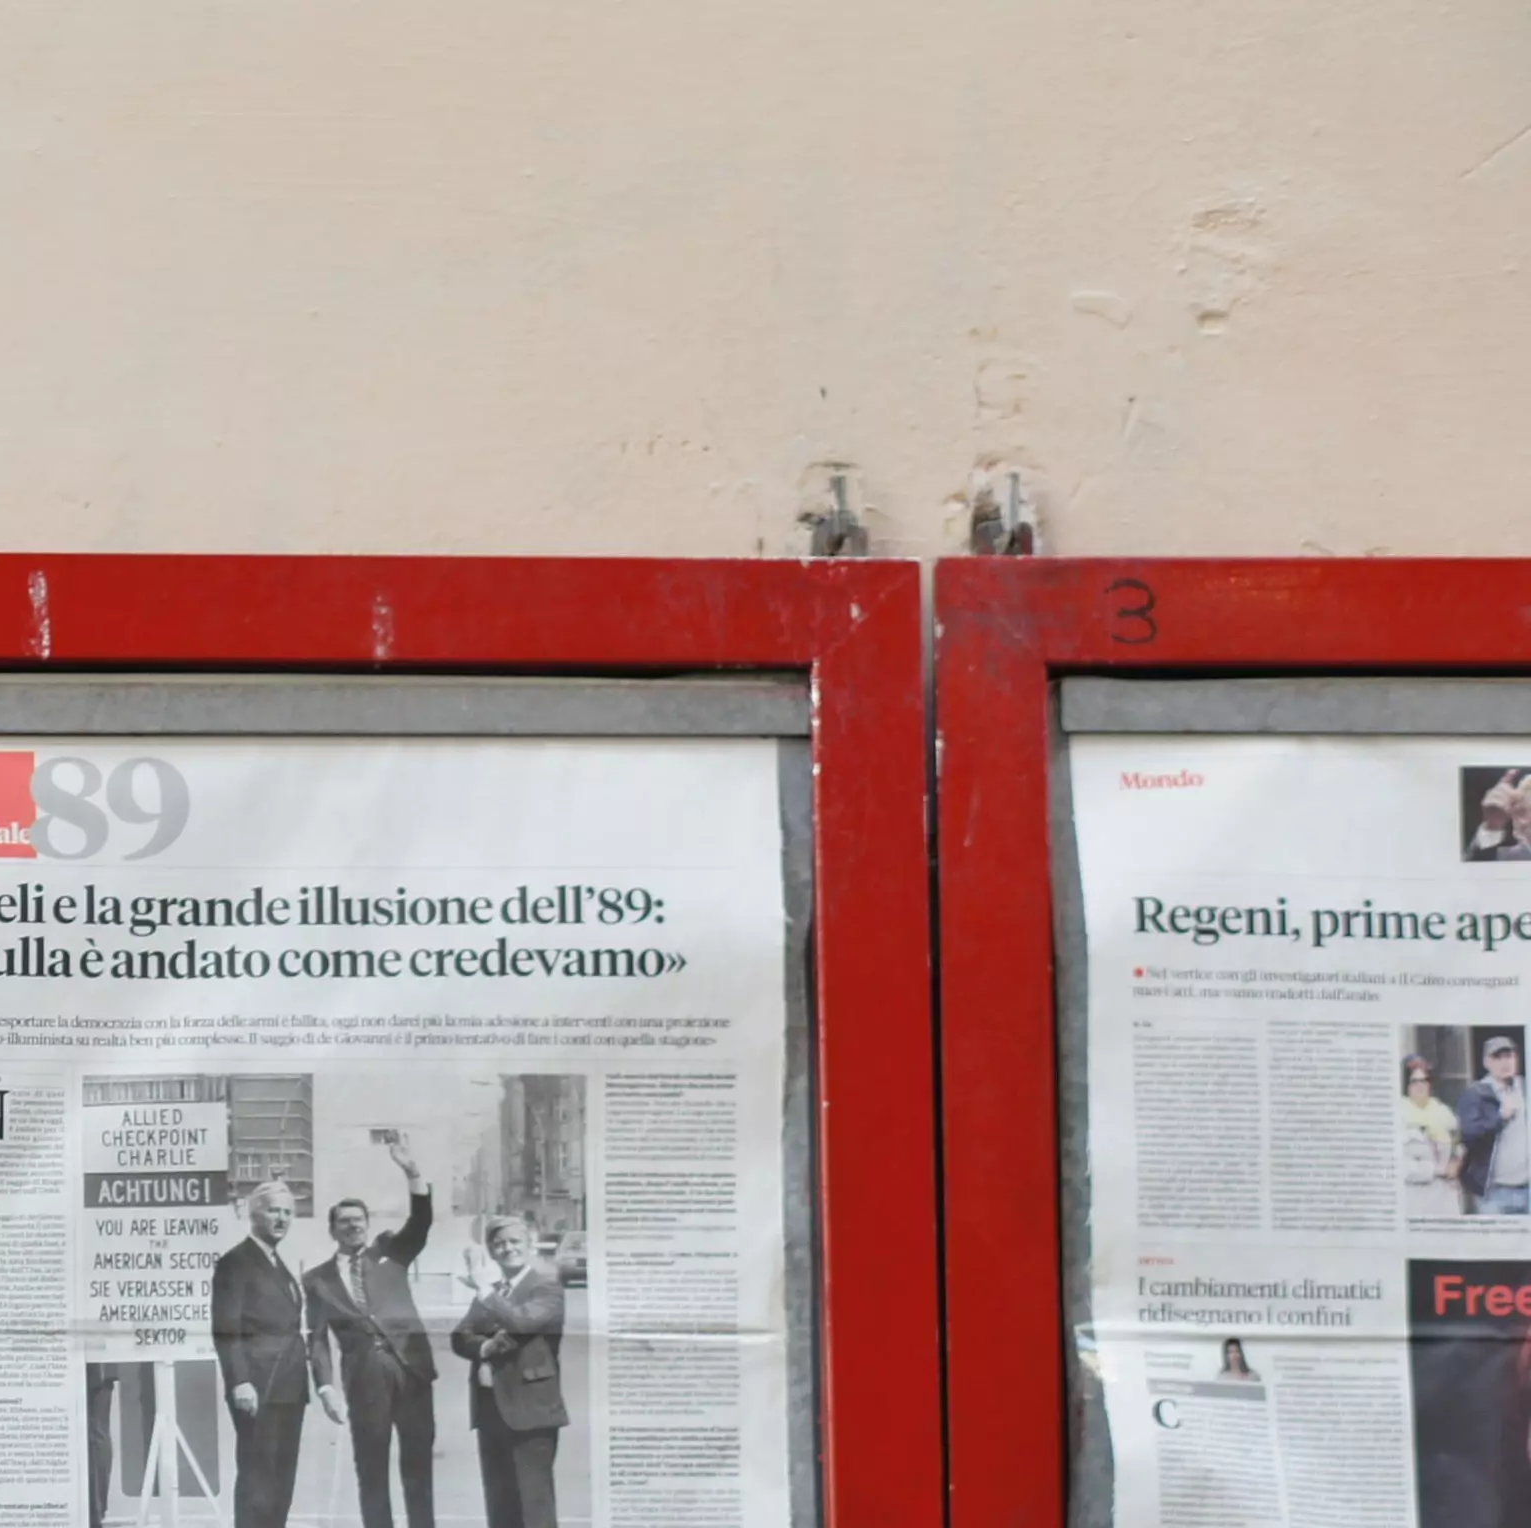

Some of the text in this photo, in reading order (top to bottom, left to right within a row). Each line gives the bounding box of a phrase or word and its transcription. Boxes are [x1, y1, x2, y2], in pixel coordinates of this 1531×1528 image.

[1120, 769, 1204, 790] Mondo
[29, 754, 192, 863] 89
[52, 895, 77, 925] e
[83, 884, 125, 926] la
[129, 886, 290, 937] grande
[298, 885, 493, 926] illusione
[1135, 897, 1301, 946] Regeni,
[1311, 899, 1447, 948] prime
[79, 937, 104, 979] è
[110, 939, 271, 980] andato
[278, 949, 402, 978] come
[409, 937, 687, 978] credevamo»
[122, 1108, 183, 1127] ALLIED
[101, 1128, 208, 1147] CHECKPOINT
[117, 1148, 197, 1167] CHARLIE
[98, 1178, 210, 1204] ACHTUNG!
[95, 1218, 219, 1237] YOU ARE LEAVING
[93, 1252, 163, 1270] AMERICAN
[89, 1280, 110, 1298] SIE
[117, 1280, 194, 1298] VERLASSEN
[1138, 1275, 1382, 1301] I cambiamenti climatici
[99, 1305, 209, 1322] AMERIKANISCHE
[1137, 1300, 1264, 1325] ridisegnano
[1276, 1305, 1352, 1327] confini
[133, 1327, 187, 1346] SEKTOR
